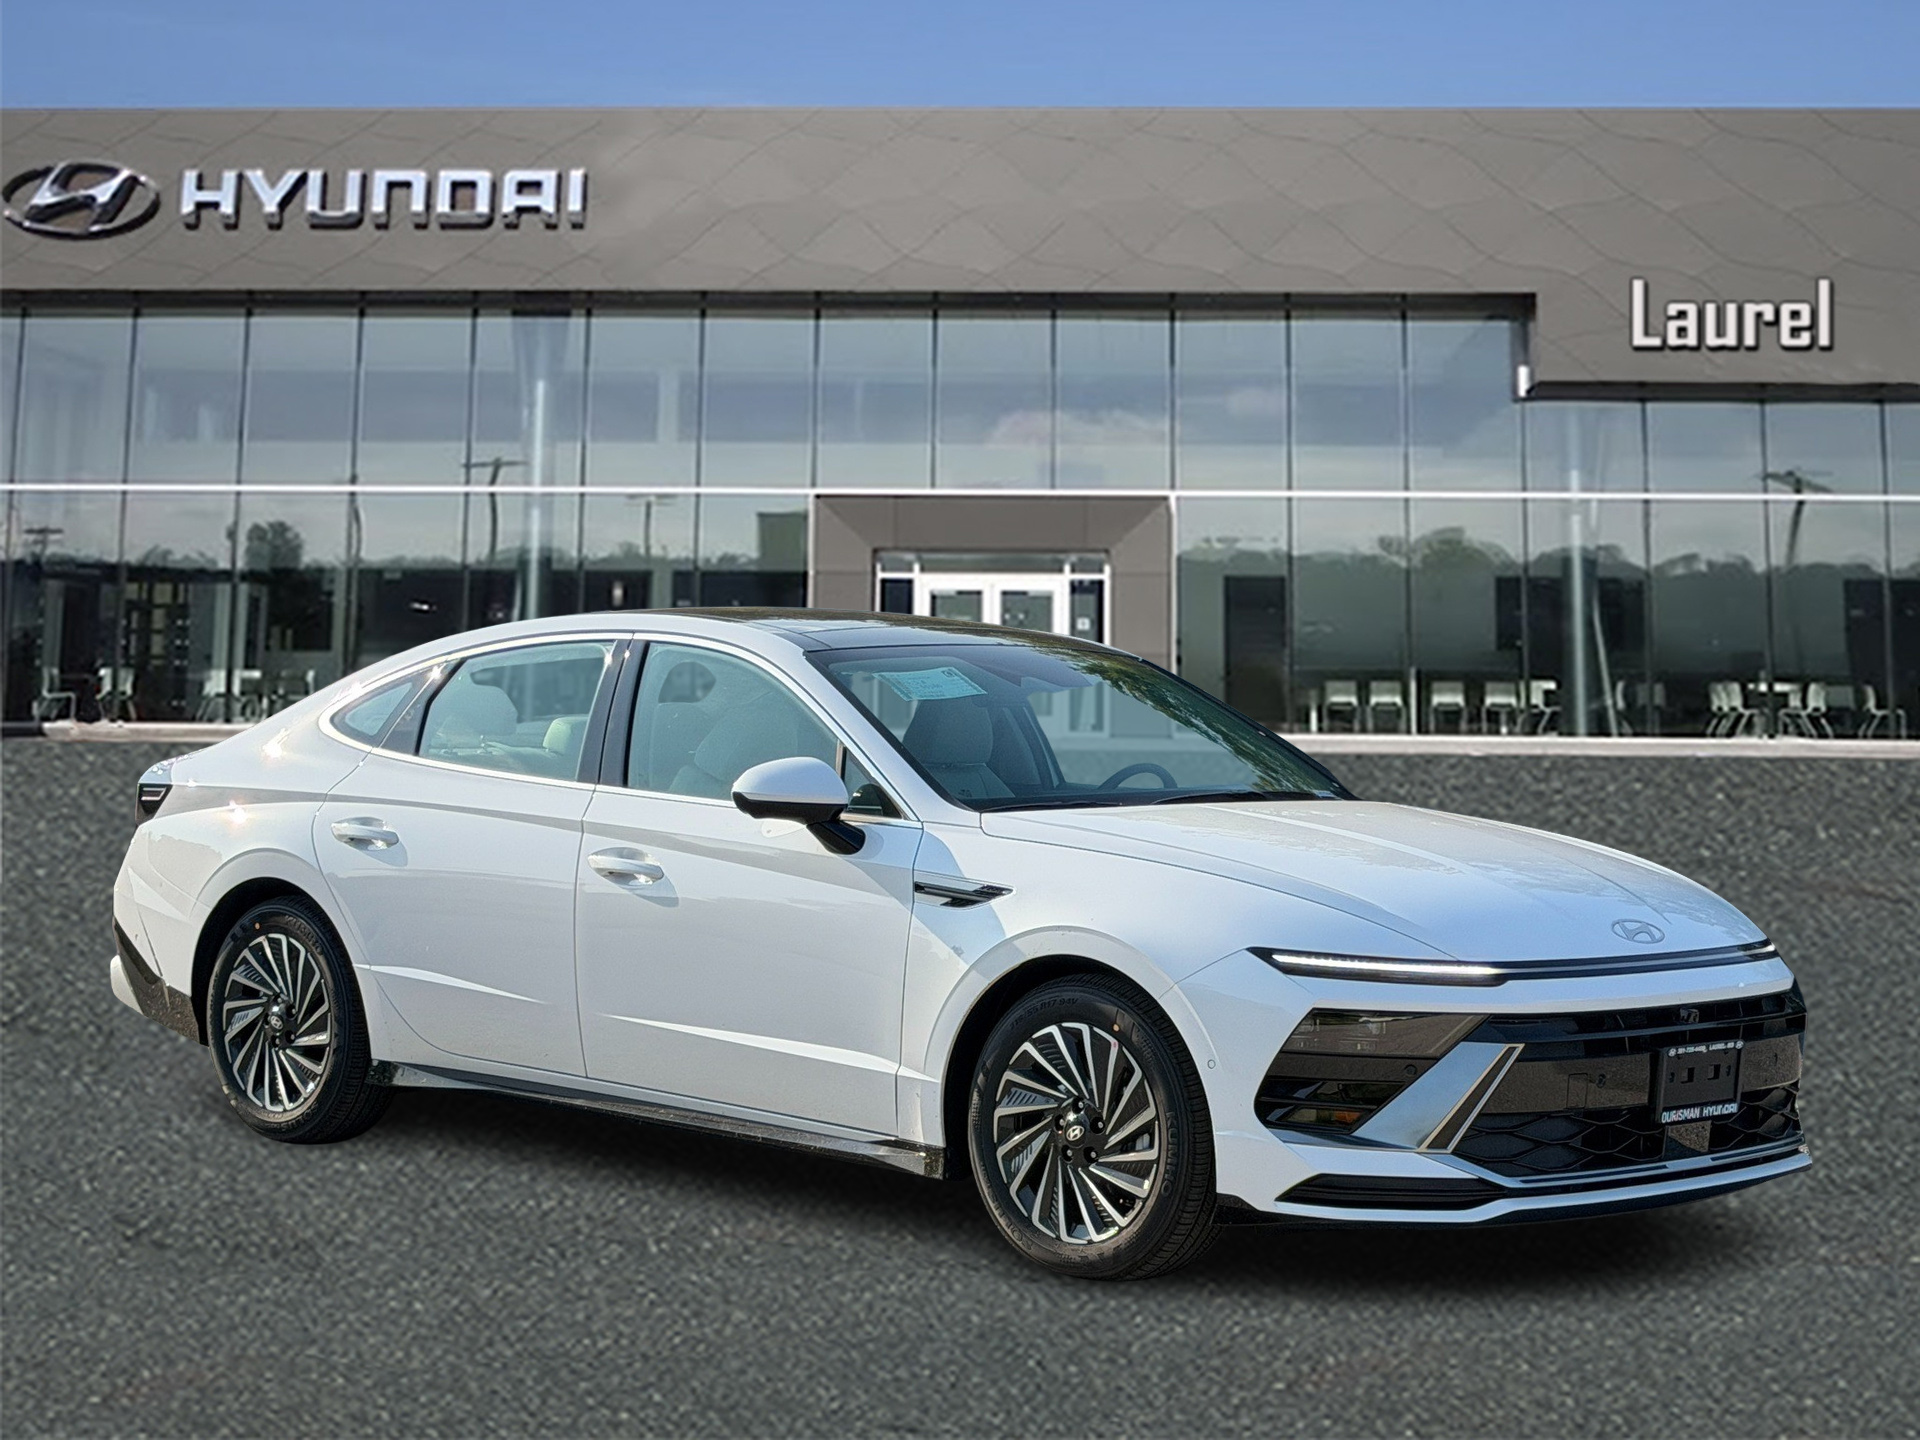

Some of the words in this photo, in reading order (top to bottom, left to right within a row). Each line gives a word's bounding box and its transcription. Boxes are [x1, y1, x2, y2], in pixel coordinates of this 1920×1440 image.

[181, 169, 588, 230] HYUNDAI
[1631, 278, 1831, 348] Laurel
[1661, 1106, 1700, 1123] OURISMAN
[1160, 1111, 1179, 1195] KUMHO
